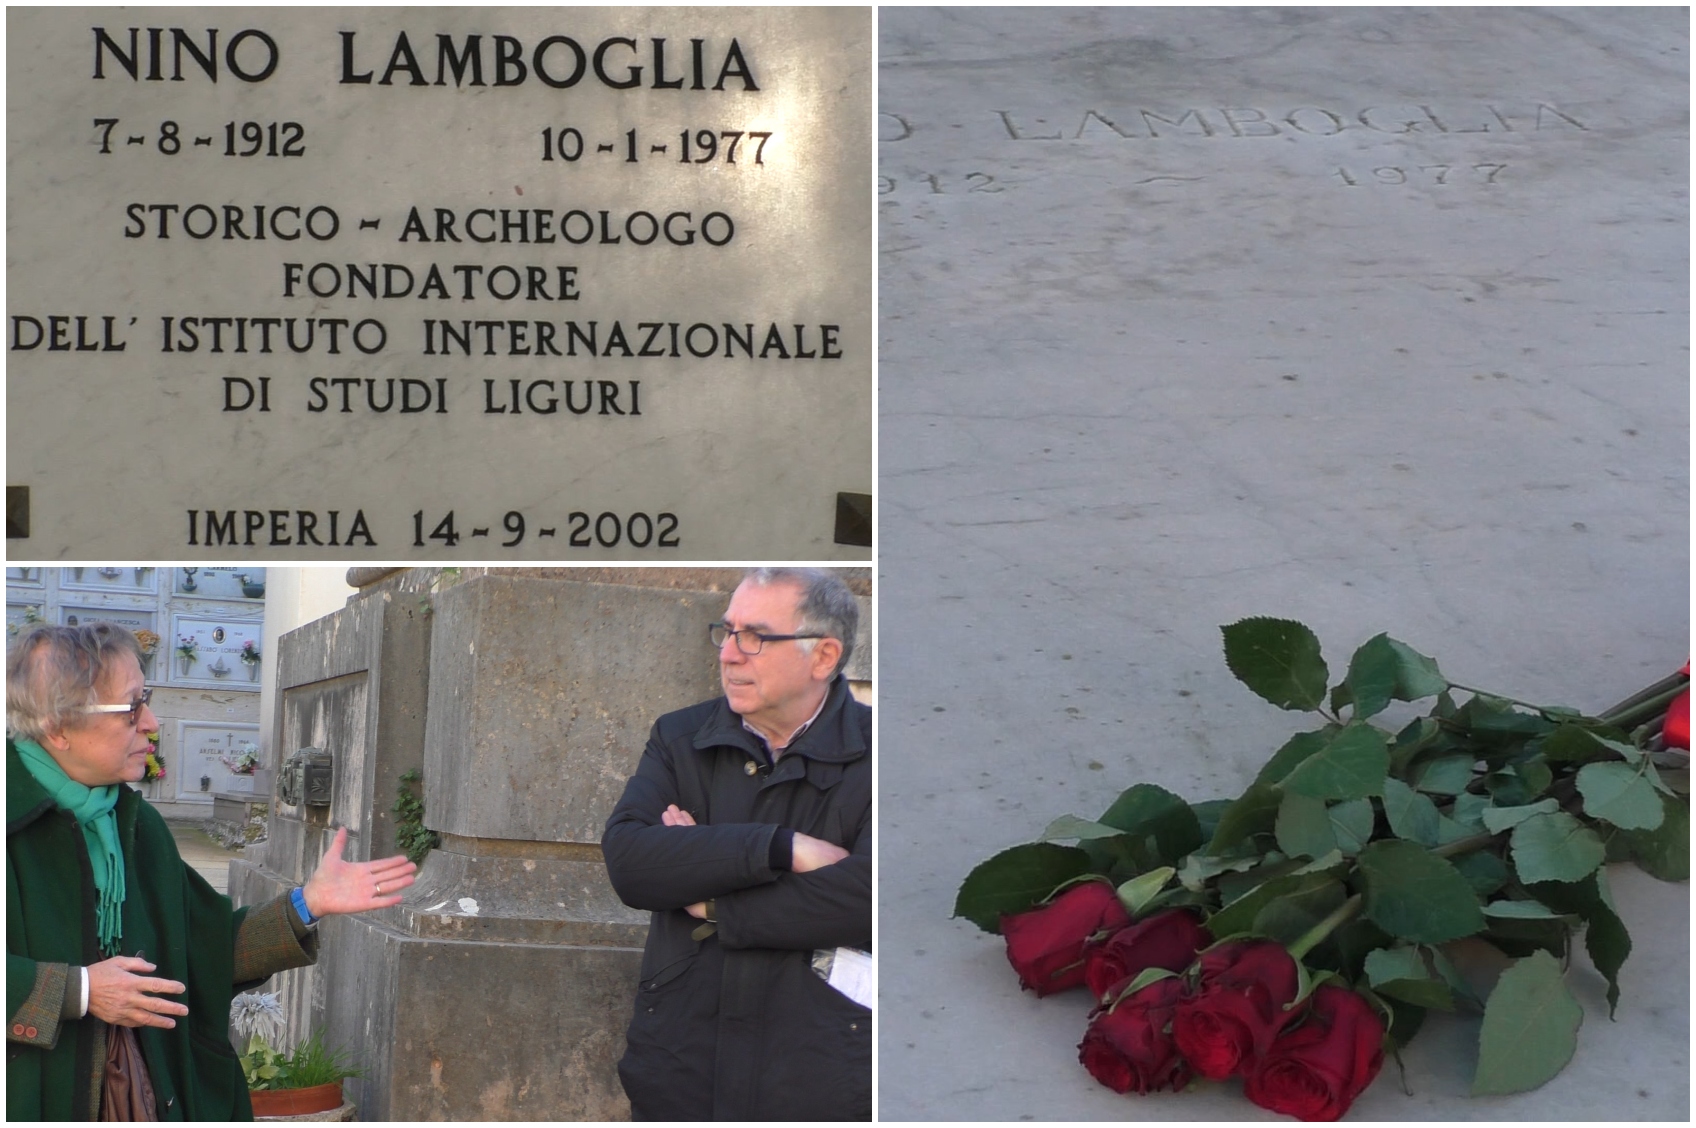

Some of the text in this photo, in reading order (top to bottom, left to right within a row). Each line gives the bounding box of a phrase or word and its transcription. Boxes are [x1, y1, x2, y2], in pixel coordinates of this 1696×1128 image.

[91, 26, 762, 92] NINO LAMBOGLIA
[990, 103, 1592, 140] LAMBOGLIA
[1332, 163, 1508, 187] 1977
[124, 202, 340, 241] STORICO
[398, 205, 735, 247] ARCHEOLOGO
[282, 262, 581, 301] FONDATORE
[10, 315, 844, 360] DELL' ISTITUTO INTERNAZIONALE
[222, 376, 642, 416] DI STUDI LIGURI
[186, 509, 378, 547] IMPERIA
